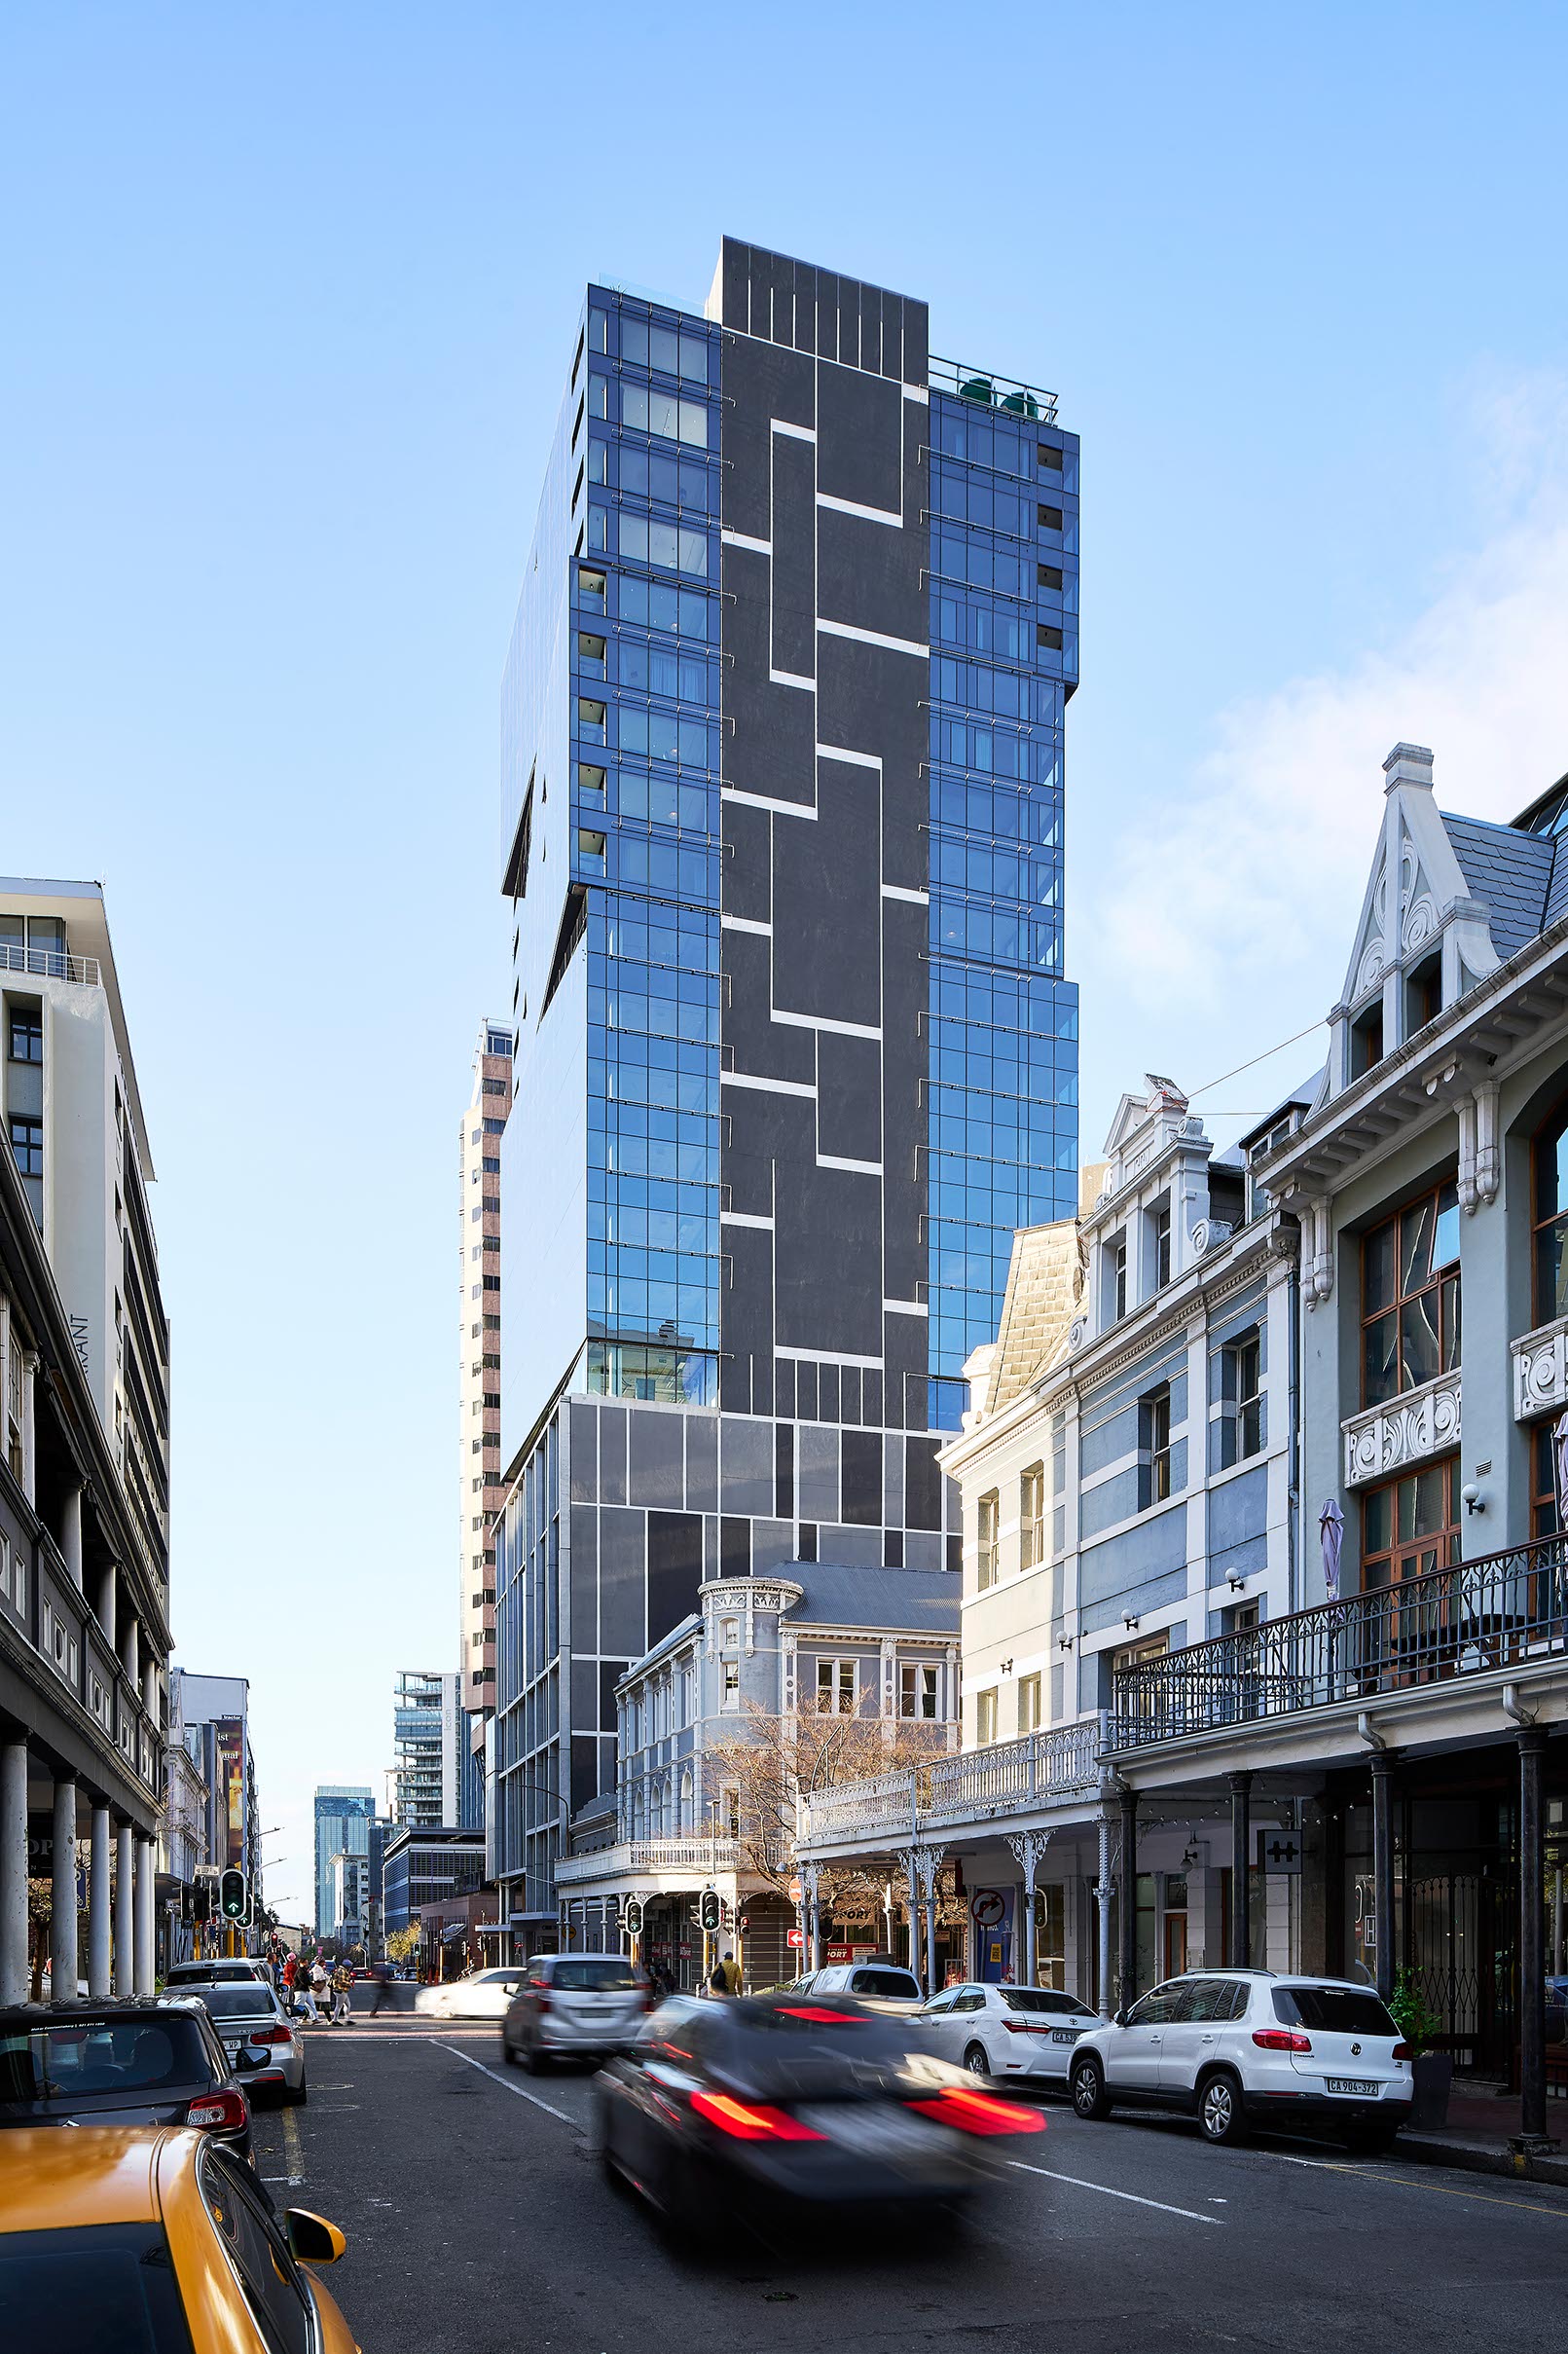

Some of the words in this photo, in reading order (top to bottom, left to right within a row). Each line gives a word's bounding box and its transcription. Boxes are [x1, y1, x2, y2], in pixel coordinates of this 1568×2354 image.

[70, 1313, 89, 1374] ANT
[1331, 2080, 1342, 2091] CA
[1343, 2081, 1376, 2094] 904-372
